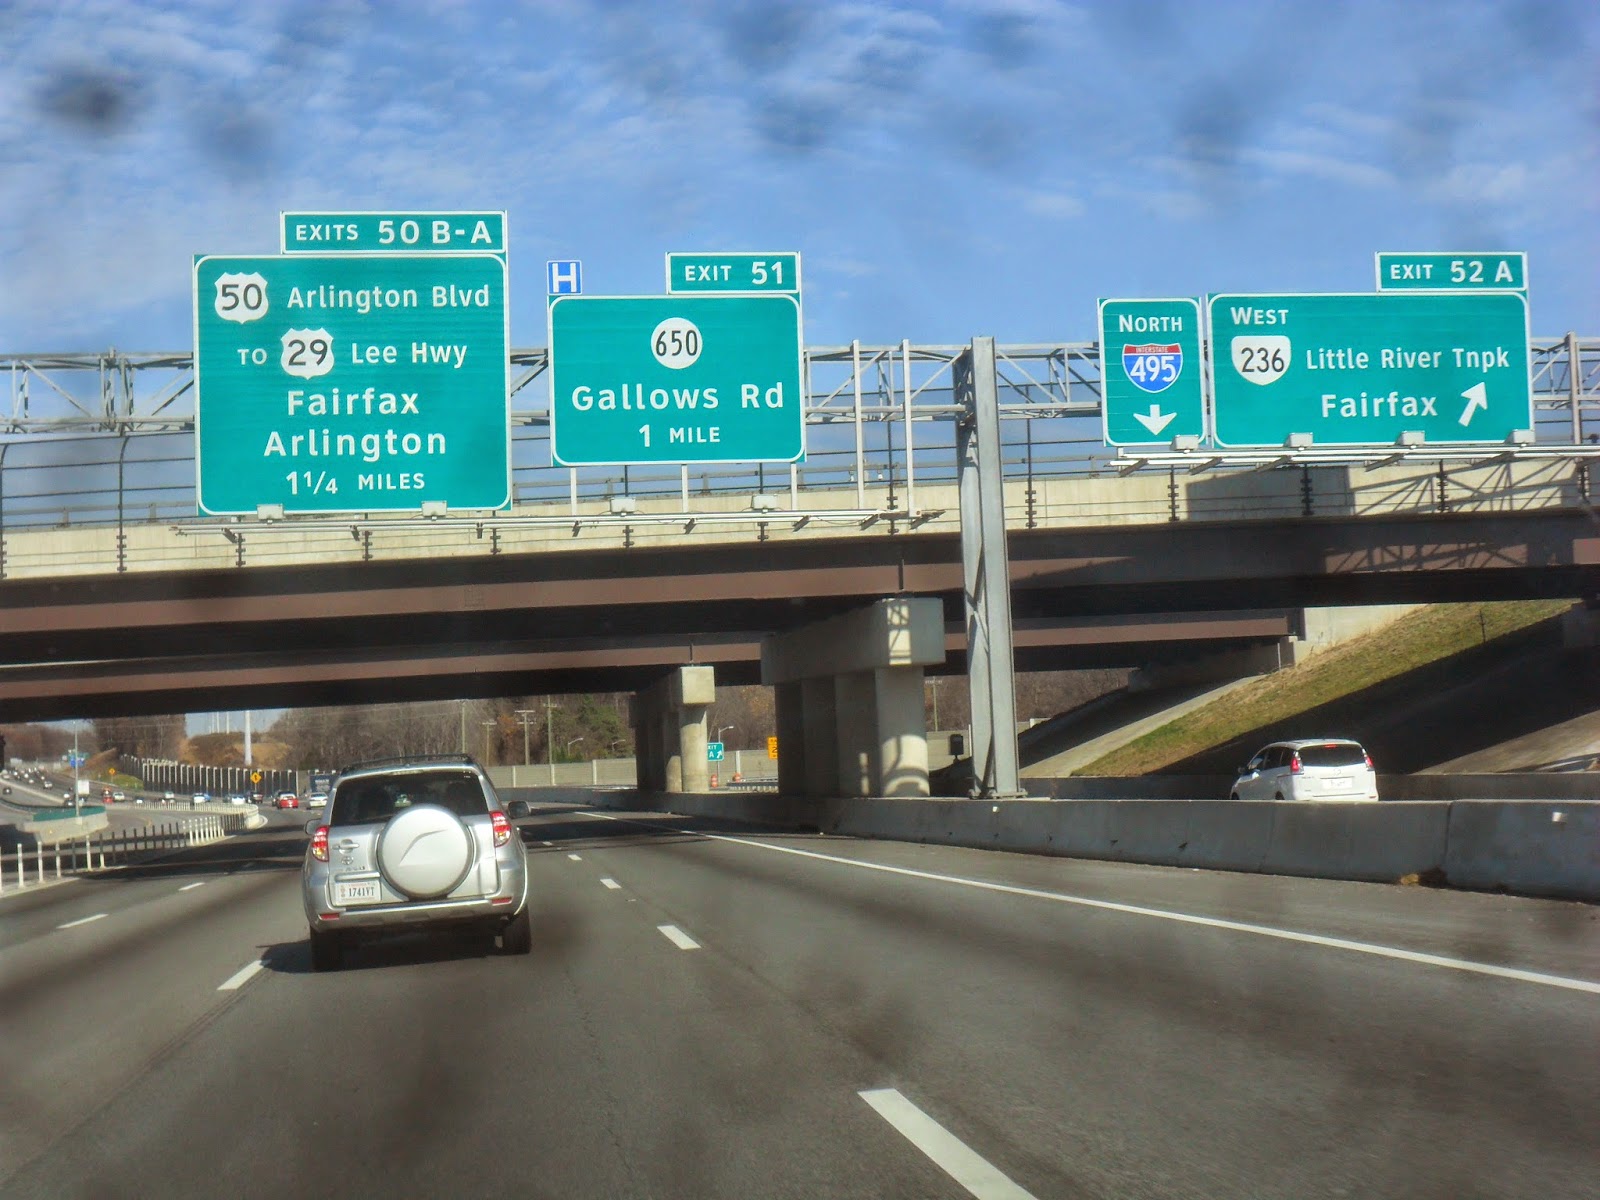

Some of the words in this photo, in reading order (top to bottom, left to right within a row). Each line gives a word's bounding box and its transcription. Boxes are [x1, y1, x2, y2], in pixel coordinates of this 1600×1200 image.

[295, 223, 359, 241] EXITS
[378, 220, 420, 244] 50
[551, 262, 577, 293] H
[684, 265, 732, 282] EXIT
[751, 261, 783, 285] 51
[1390, 264, 1433, 280] EXIT
[1450, 260, 1484, 283] 52
[1494, 260, 1514, 283] A
[221, 283, 263, 311] 50
[287, 285, 418, 314] Arlington
[432, 284, 490, 308] Blvd
[1118, 314, 1183, 333] NORTH
[1230, 306, 1289, 325] WEST
[287, 339, 328, 367] 29
[351, 342, 398, 364] Lee
[411, 342, 467, 369] Hwy
[655, 329, 699, 357] 650
[237, 348, 268, 366] TO
[1129, 355, 1177, 383] 495
[1240, 347, 1285, 373] 236
[1306, 347, 1369, 370] Little
[1380, 347, 1442, 369] River
[1452, 346, 1510, 373] Tnpk
[287, 387, 419, 416] Fairfax
[571, 383, 719, 411] Gallows
[741, 381, 784, 409] Rd
[1321, 391, 1438, 418] Fairfax
[263, 428, 446, 463] Arlington
[638, 424, 651, 448] 1
[669, 426, 721, 444] MILE
[358, 472, 425, 491] MILES
